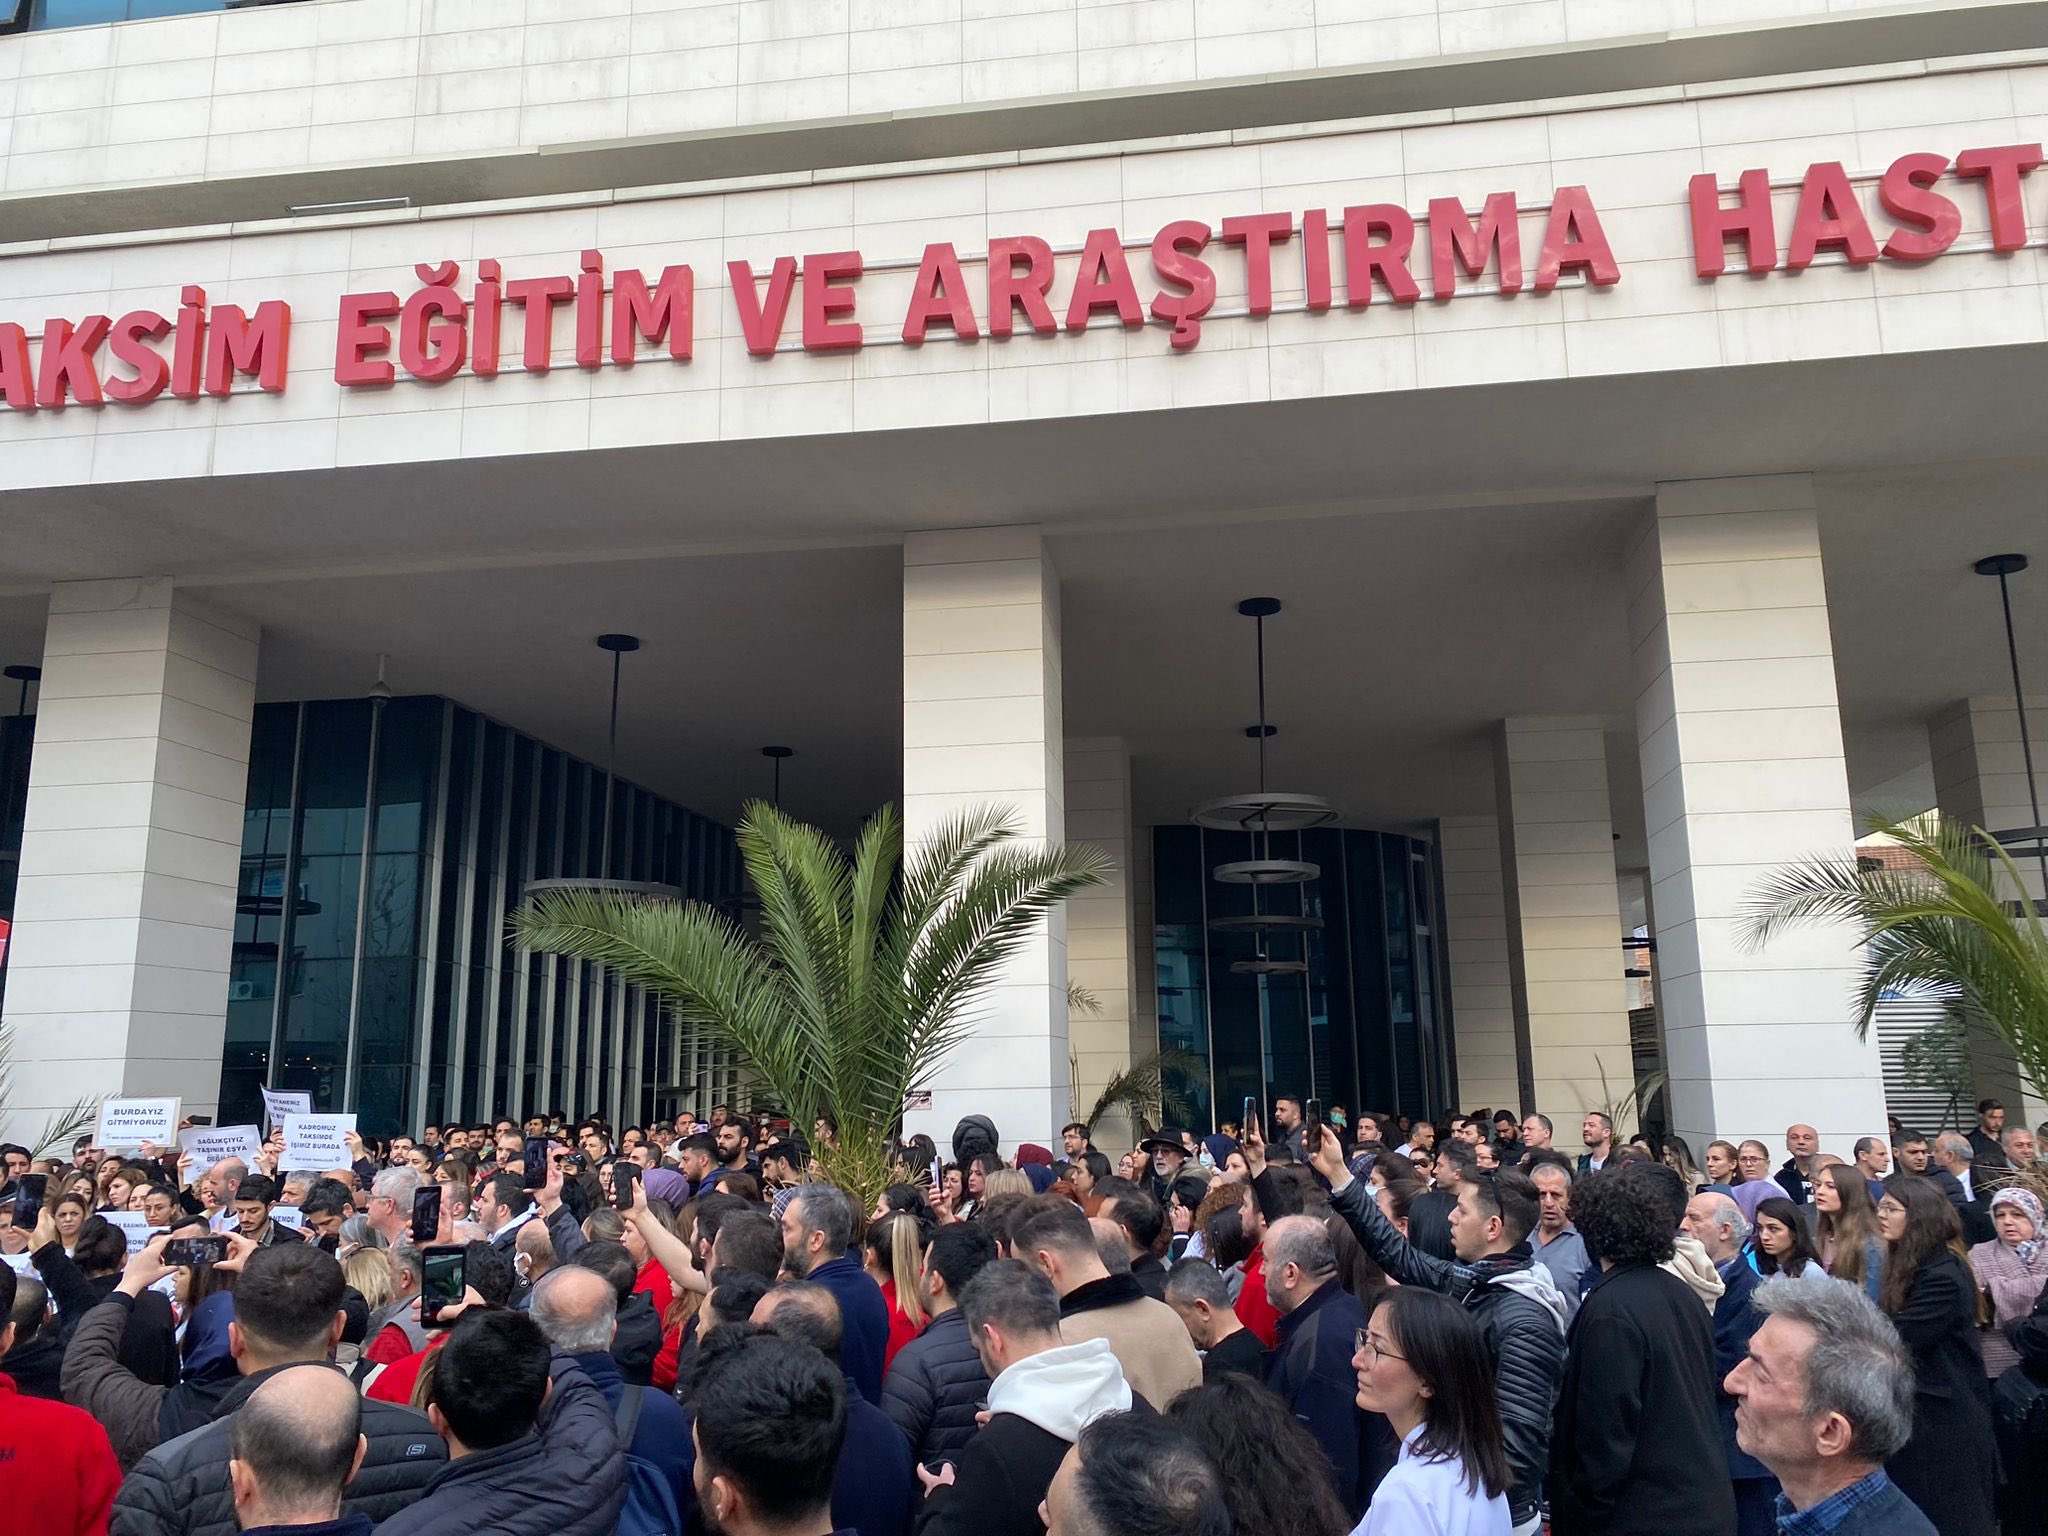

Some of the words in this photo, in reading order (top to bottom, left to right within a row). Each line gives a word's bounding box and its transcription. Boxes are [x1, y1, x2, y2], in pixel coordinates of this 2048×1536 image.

[334, 249, 694, 387] EĞİTİM
[727, 251, 863, 356] VE
[902, 185, 1621, 350] ARAŞTIRMA
[1688, 143, 2044, 278] HAST
[113, 1108, 164, 1116] BURDAYIZ
[107, 1118, 167, 1126] GİTMİYORUZ!
